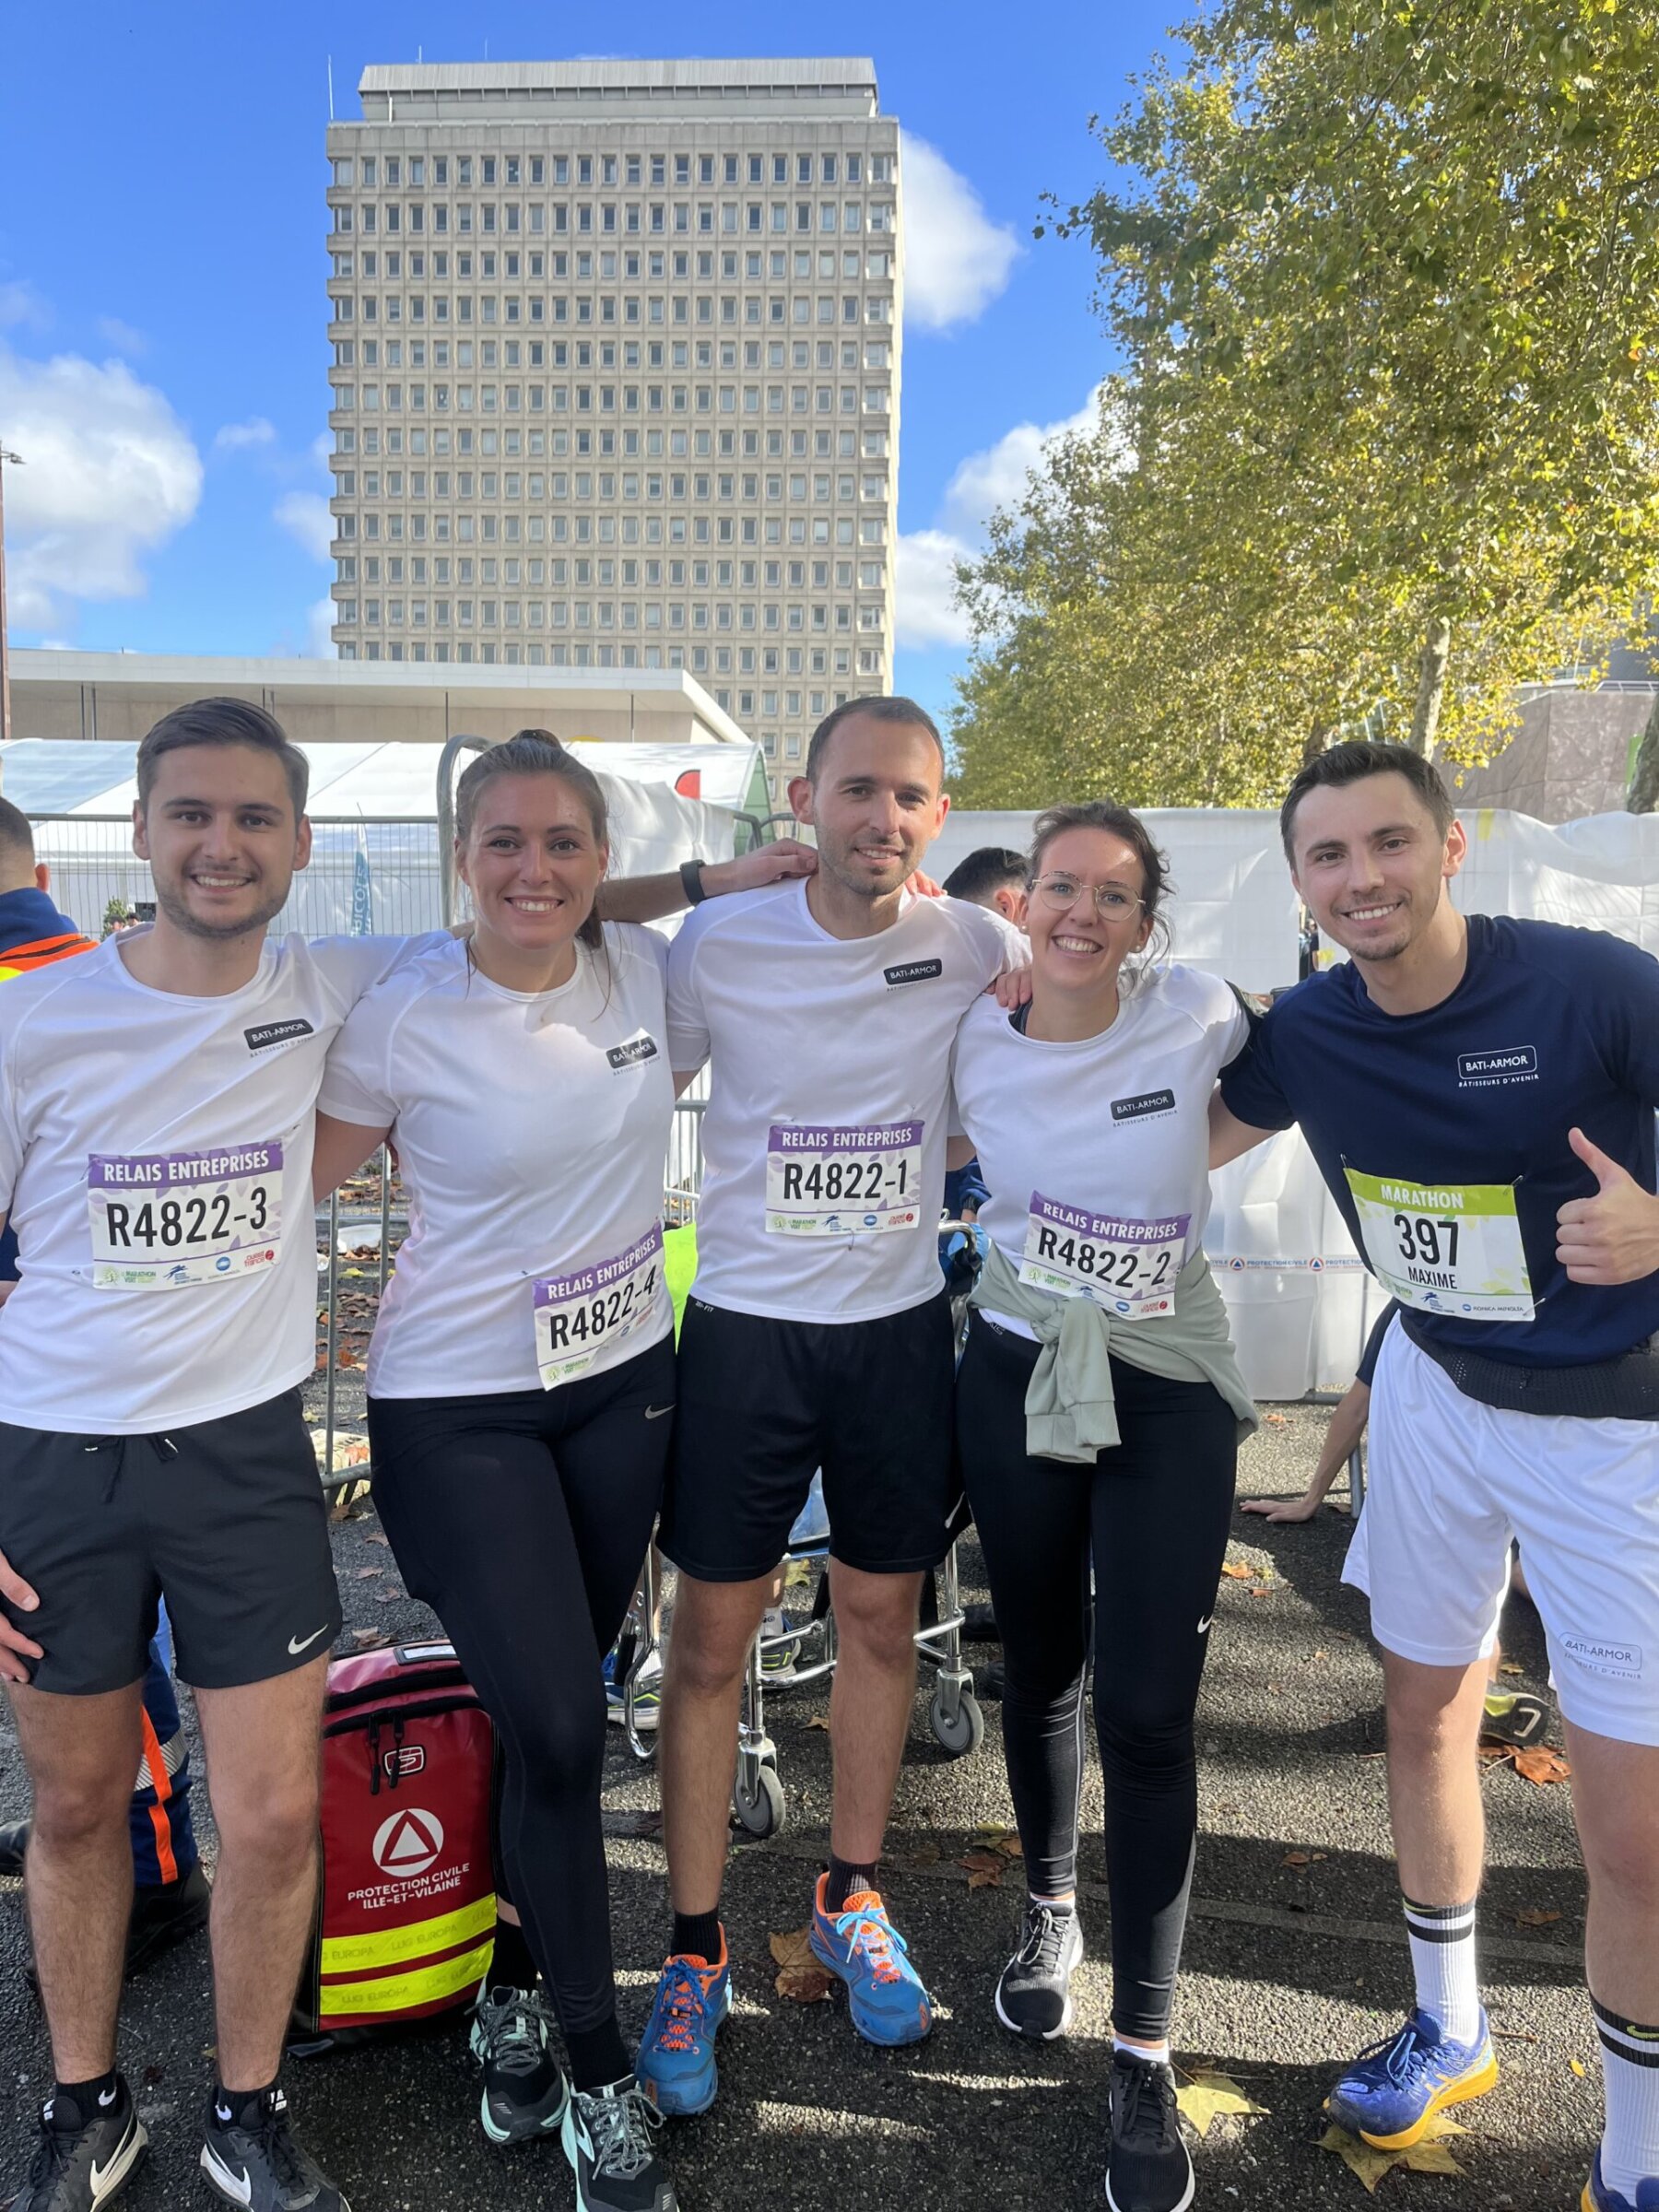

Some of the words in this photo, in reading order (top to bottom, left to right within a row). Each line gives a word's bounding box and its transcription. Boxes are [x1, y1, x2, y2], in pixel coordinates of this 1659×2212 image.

[889, 965, 937, 979] BATI-ARMOR
[251, 1023, 306, 1042] BATI-ARMOR
[1465, 1055, 1528, 1071] BATI-ARMOR
[1502, 1074, 1539, 1084] D'AVENIR
[1116, 1096, 1169, 1113] BATI-ARMOR
[782, 1132, 828, 1147] RELAIS
[833, 1127, 912, 1147] ENTREPRISES
[104, 1164, 161, 1182] RELAIS
[169, 1150, 269, 1181] ENTREPRISES
[783, 1159, 907, 1200] R4822-1
[1381, 1184, 1464, 1209] MARATHON
[107, 1187, 267, 1248] R4822-3
[1043, 1202, 1088, 1229] RELAIS
[1091, 1219, 1178, 1240] ENTREPRISES
[1394, 1214, 1459, 1267] 397
[547, 1274, 594, 1300] RELAIS
[596, 1234, 655, 1284] ENTREPRISES
[1038, 1227, 1171, 1288] R4822-2
[1407, 1266, 1457, 1289] MAXIME
[550, 1265, 657, 1350] R4822-4
[1565, 1640, 1633, 1662] BATI-ARMOR
[347, 1877, 429, 1900] PROTECTION
[431, 1863, 470, 1883] CIVILE
[363, 1876, 461, 1910] ILLE-ET-VILAINE
[417, 1924, 457, 1943] EUROPA
[332, 1946, 375, 1960] EUROPA
[368, 1986, 409, 2002] EUROPA
